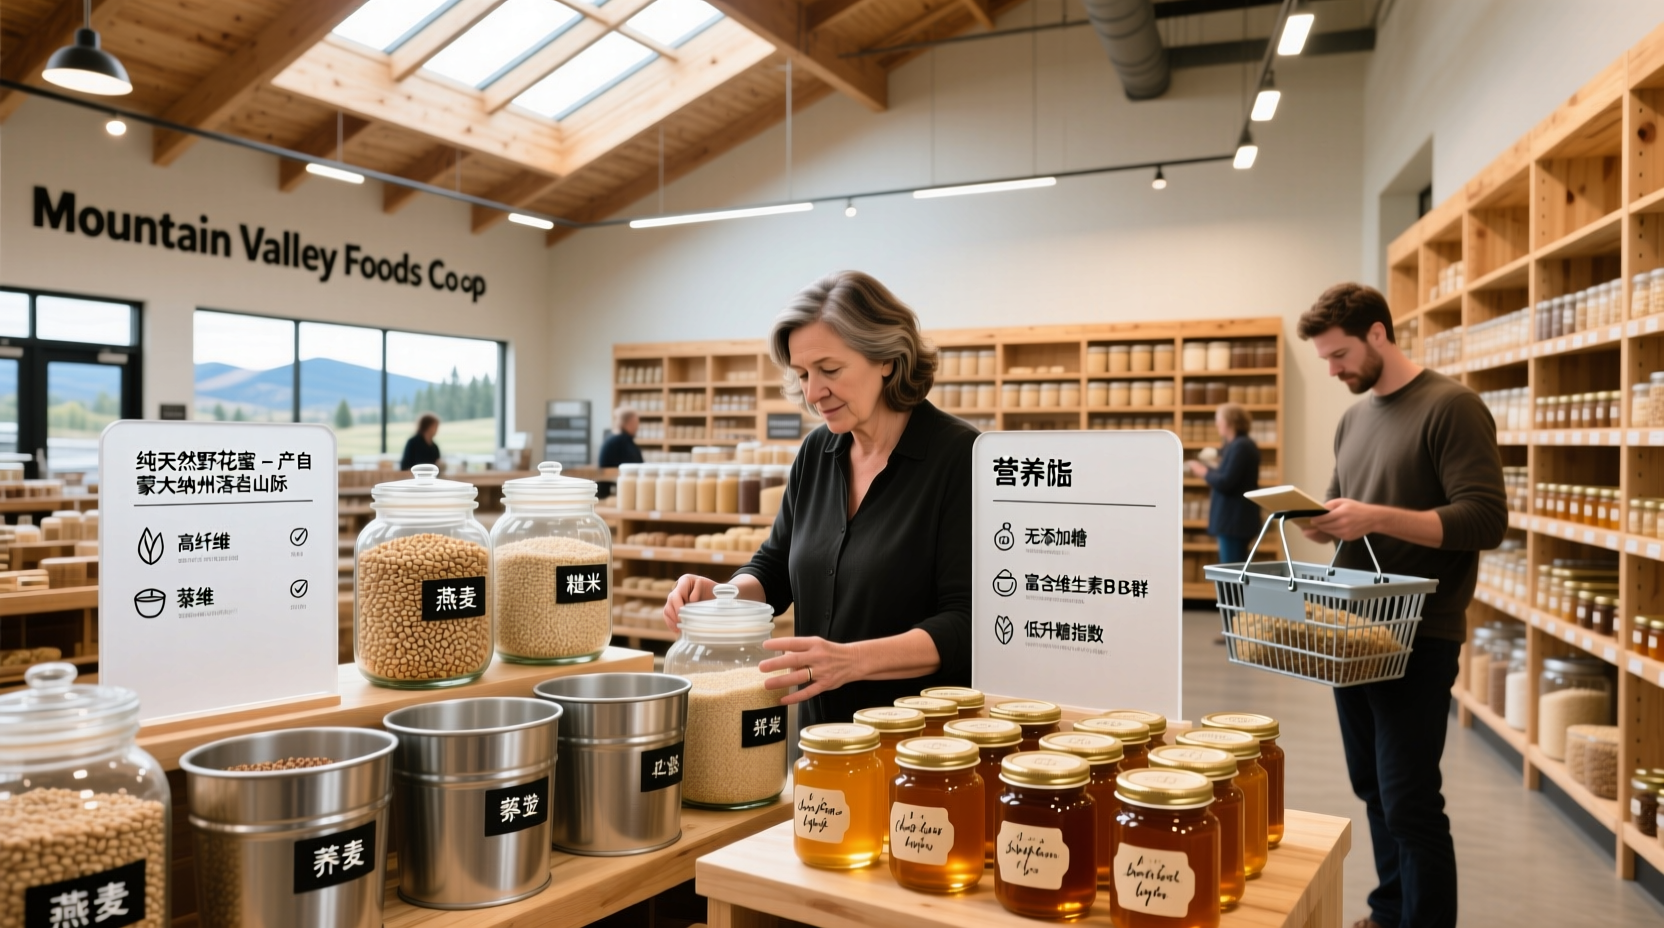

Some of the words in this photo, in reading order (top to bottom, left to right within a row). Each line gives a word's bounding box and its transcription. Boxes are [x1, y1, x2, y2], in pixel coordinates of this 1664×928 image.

[32, 185, 232, 258] Mountain
[239, 223, 338, 283] Valley
[344, 243, 423, 288] Foods
[277, 450, 312, 471] 产自
[177, 531, 231, 553] 高纤维
[1024, 527, 1088, 548] 无添加糖
[436, 585, 478, 612] 燕麦
[1024, 620, 1104, 644] 低升糖指数
[49, 881, 130, 928] 燕麦
